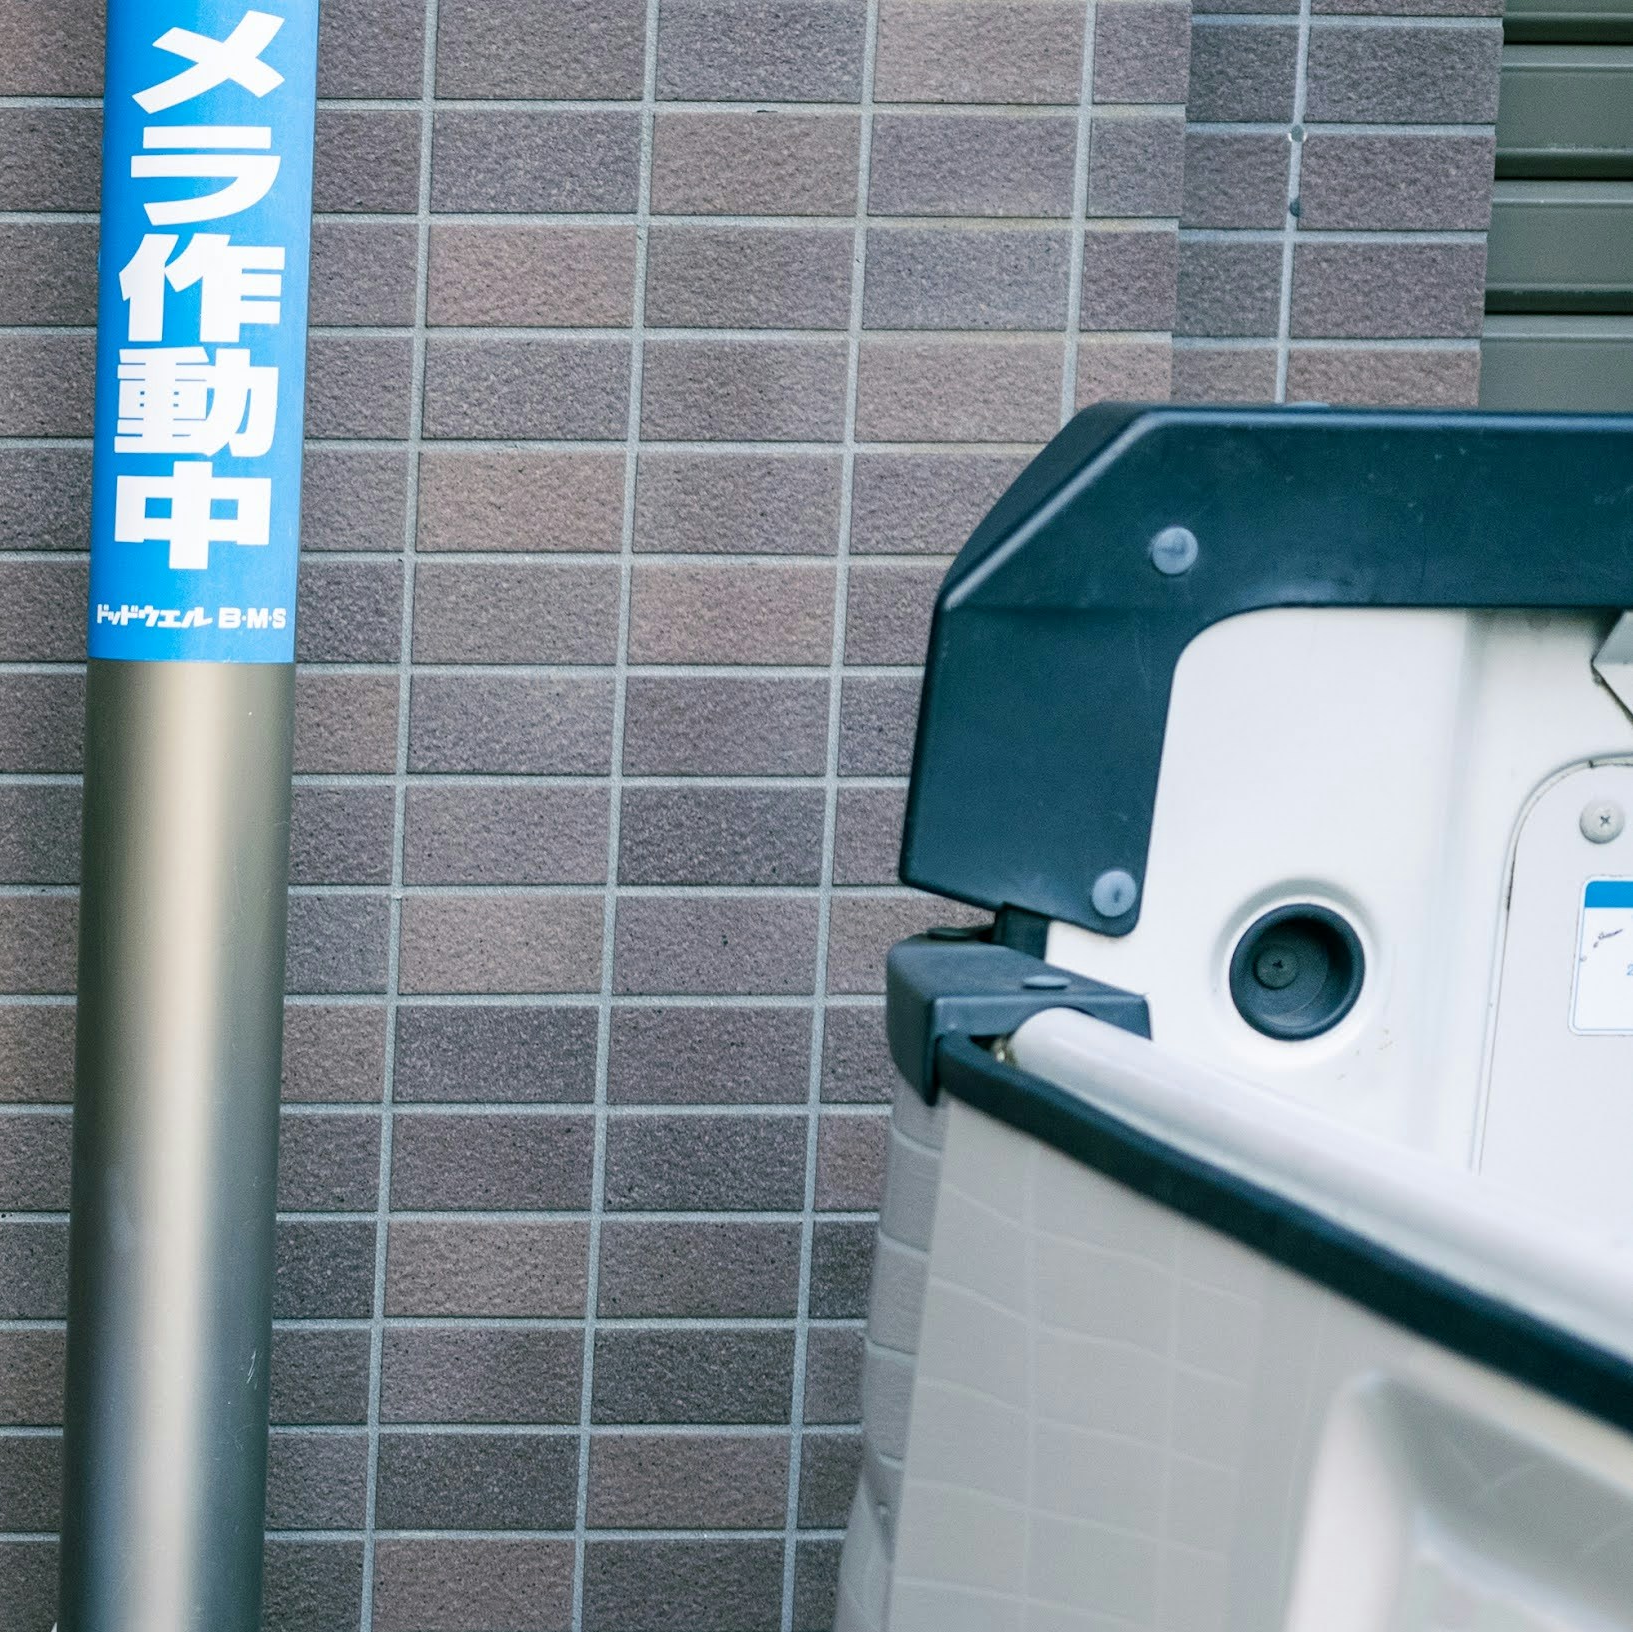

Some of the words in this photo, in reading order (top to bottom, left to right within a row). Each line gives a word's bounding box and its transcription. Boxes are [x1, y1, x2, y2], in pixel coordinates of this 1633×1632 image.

[114, 10, 286, 571] メラ作動中
